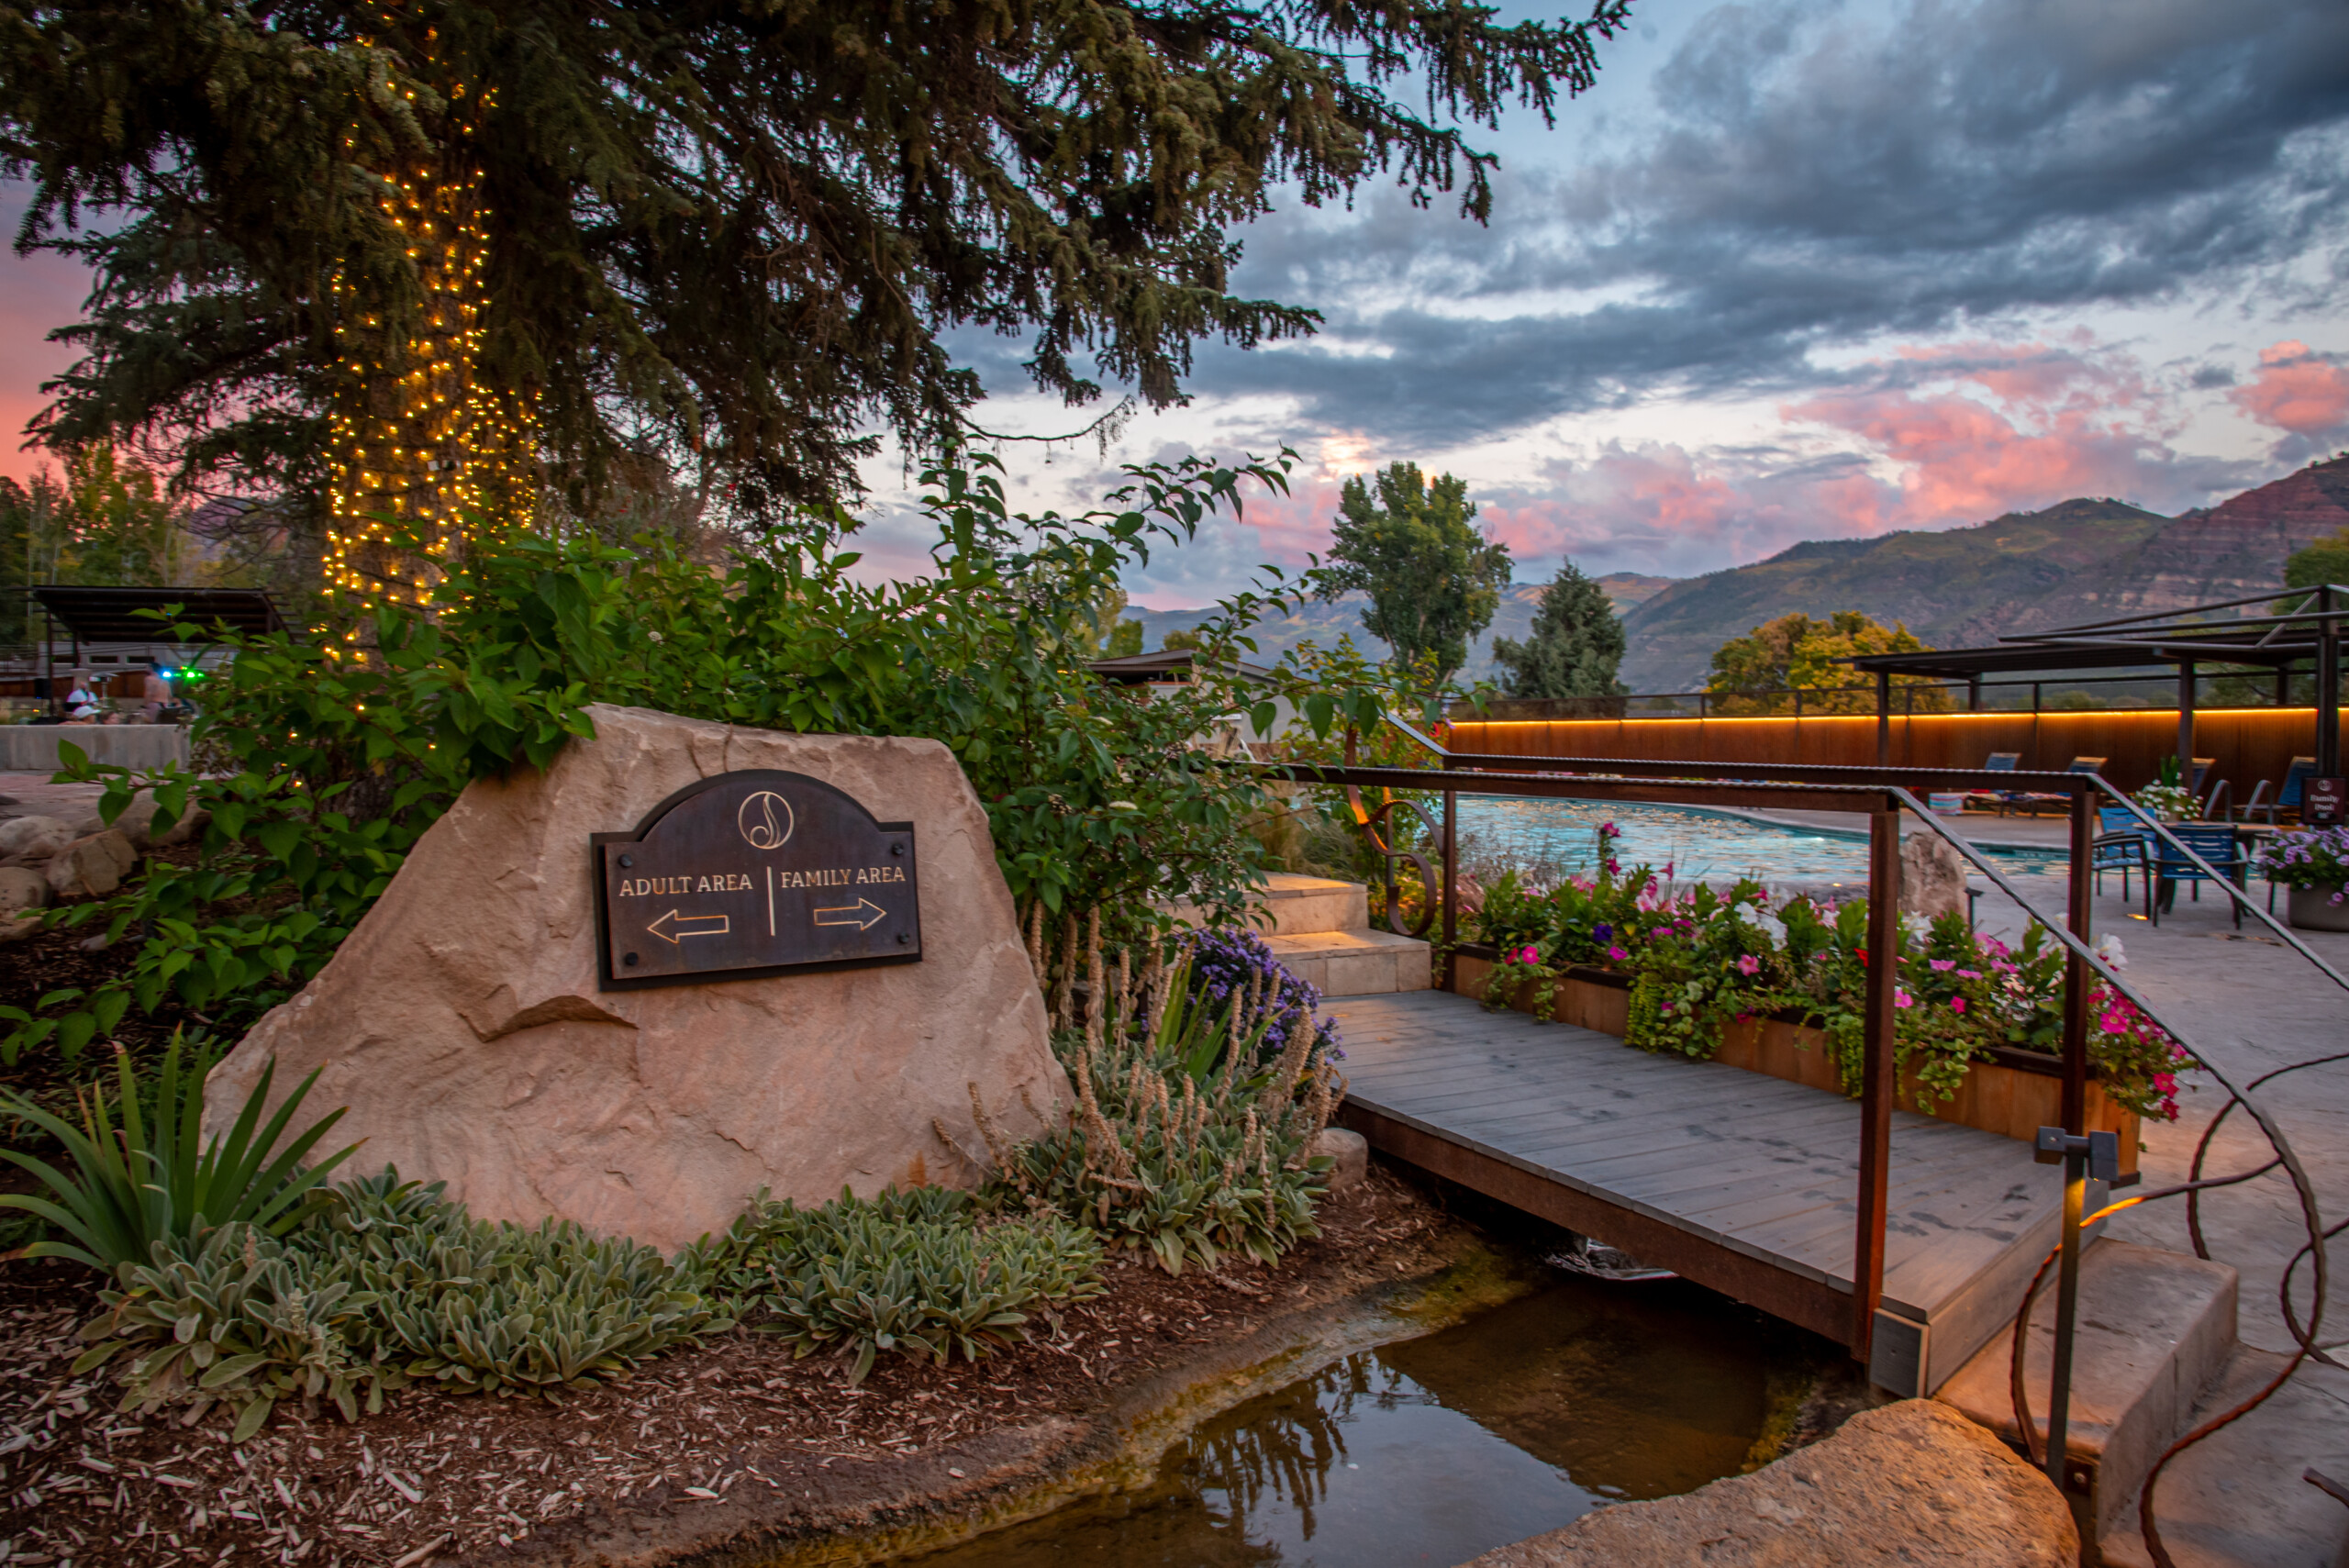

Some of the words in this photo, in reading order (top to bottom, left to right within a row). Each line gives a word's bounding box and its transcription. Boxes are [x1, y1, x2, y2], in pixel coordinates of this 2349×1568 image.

[619, 876, 692, 896] ADULT
[696, 873, 753, 893] AREA
[781, 869, 852, 888] FAMILY
[855, 866, 906, 884] AREA
